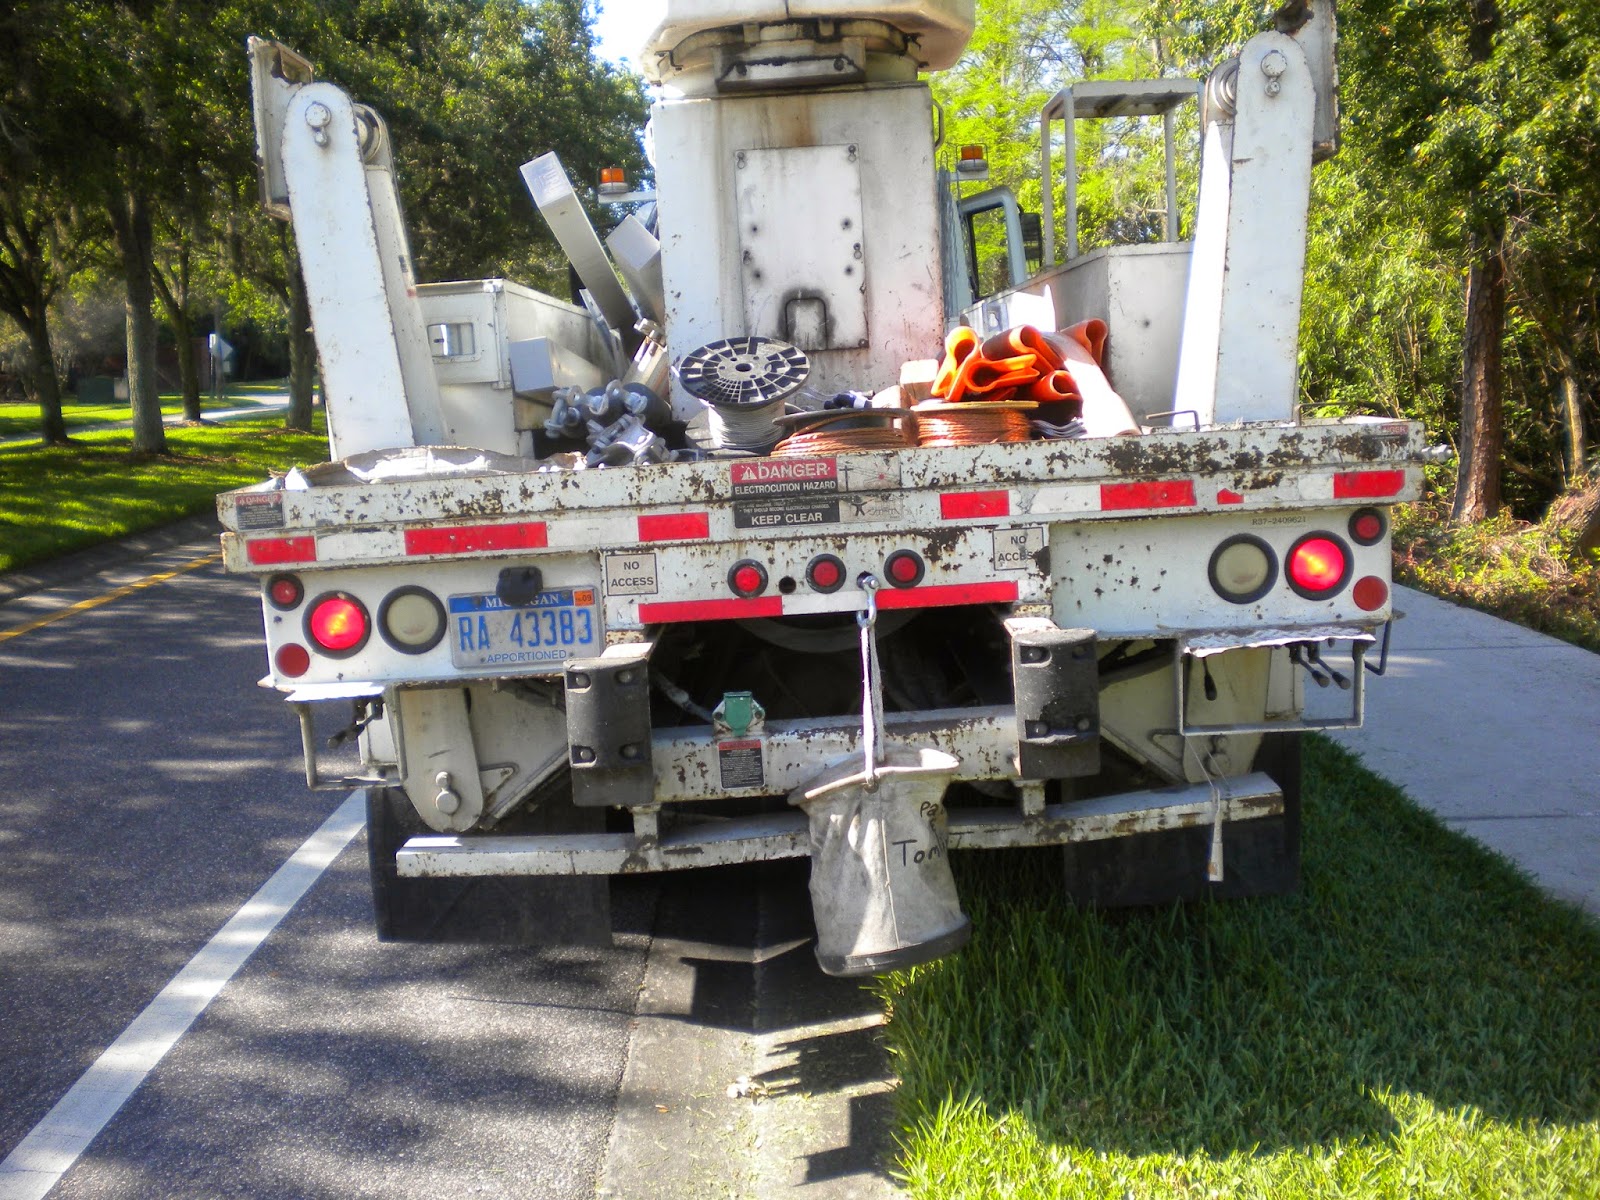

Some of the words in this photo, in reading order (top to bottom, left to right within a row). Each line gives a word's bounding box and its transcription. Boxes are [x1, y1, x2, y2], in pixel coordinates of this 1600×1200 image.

[758, 462, 829, 480] DANGER
[735, 482, 800, 495] ELECTROCUTION
[803, 480, 836, 491] HAZARD
[751, 514, 781, 525] KEEP
[785, 512, 823, 523] CLEAR
[1010, 535, 1027, 544] NO
[623, 561, 640, 570] NO
[611, 576, 654, 587] ACCESS
[485, 593, 560, 608] MIGAN
[458, 615, 491, 651] RA
[510, 608, 593, 648] 43383
[487, 650, 567, 663] APPORTIONED
